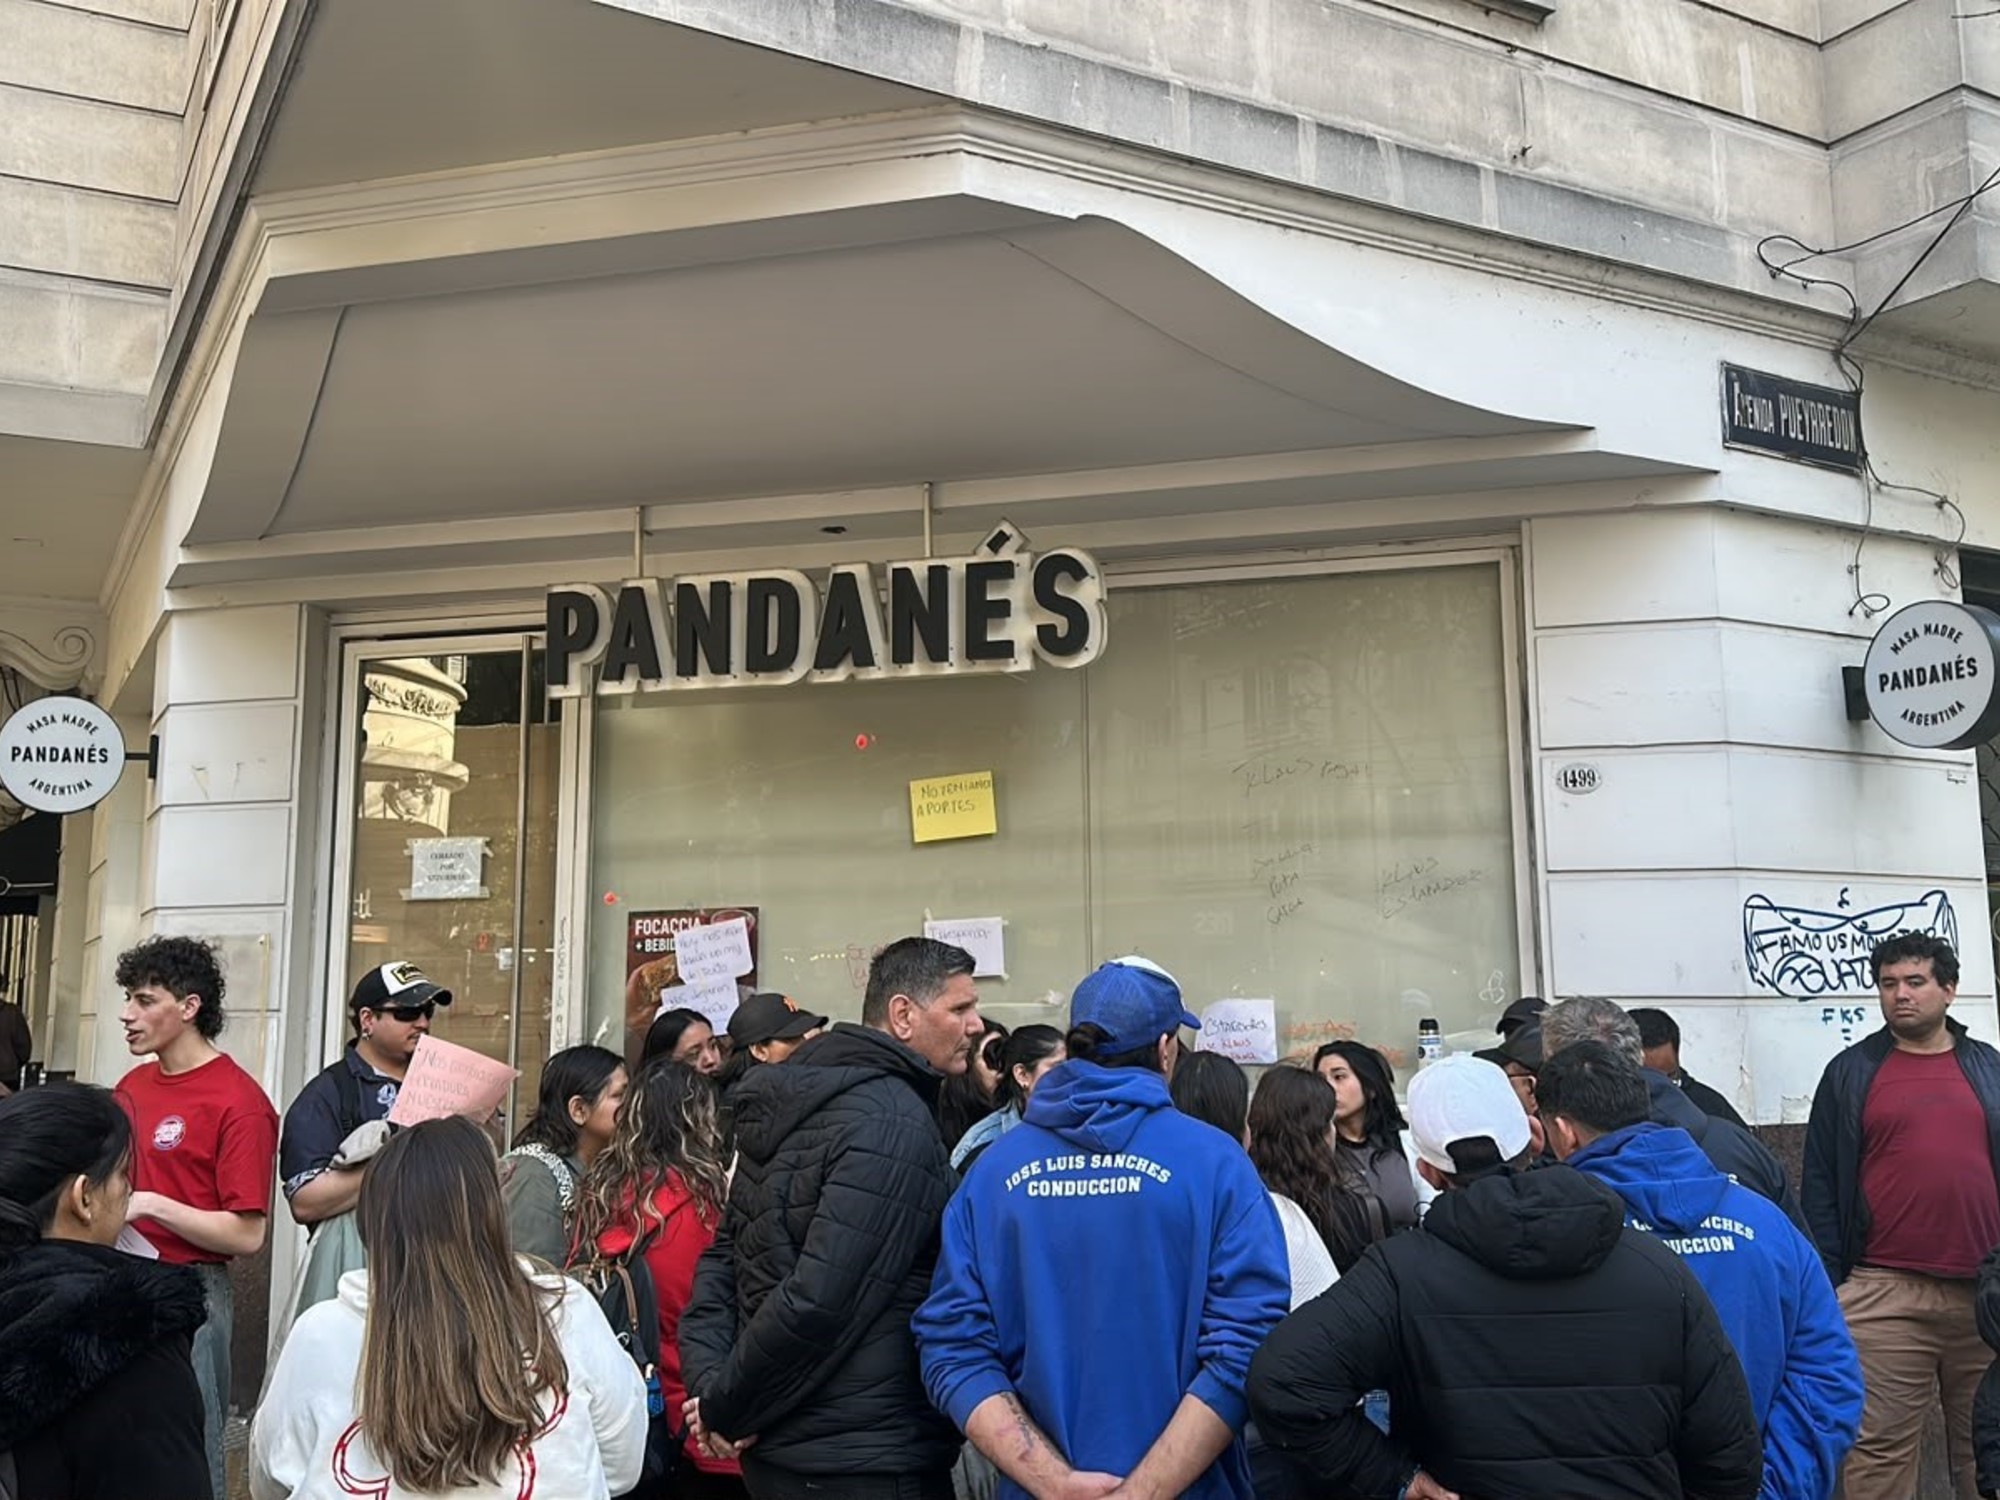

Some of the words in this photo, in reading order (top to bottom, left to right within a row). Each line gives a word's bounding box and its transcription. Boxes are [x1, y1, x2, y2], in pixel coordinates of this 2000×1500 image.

[1779, 393, 1857, 452] PUEYRREDON
[546, 530, 1096, 686] PANDANÉS
[1890, 628, 1919, 655] MASA
[1924, 623, 1963, 644] MADRE
[1879, 654, 1978, 692] PANDANÉS
[1900, 700, 1966, 726] ARGENTINA
[26, 714, 57, 734] MASA
[62, 713, 99, 736] MADRE
[11, 744, 108, 763] PANDANÉS
[29, 778, 93, 796] ARGENTINA
[1563, 769, 1596, 788] 1499
[916, 800, 975, 818] APORTES
[635, 917, 701, 935] FOCACCIA
[645, 938, 676, 952] BEBID
[1006, 1160, 1041, 1191] JOSE
[1046, 1155, 1085, 1172] LUIS
[1090, 1154, 1171, 1184] SANCHES
[1027, 1177, 1141, 1197] CONDUCCION
